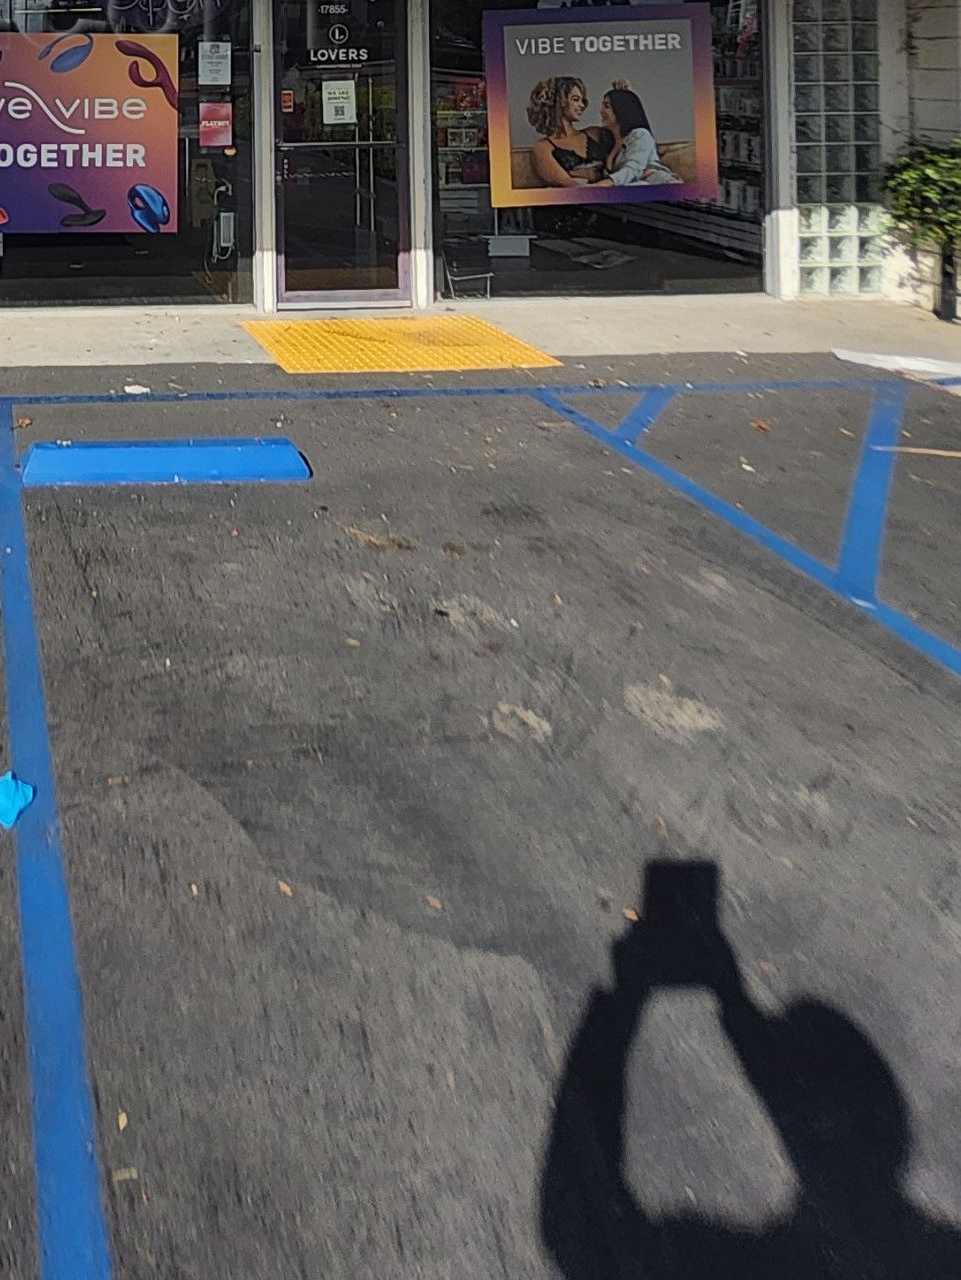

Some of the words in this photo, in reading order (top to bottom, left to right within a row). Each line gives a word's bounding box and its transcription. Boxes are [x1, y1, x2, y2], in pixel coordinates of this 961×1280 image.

[515, 36, 566, 56] VIBE
[570, 33, 682, 54] TOGETHER
[309, 49, 369, 61] LOVERS
